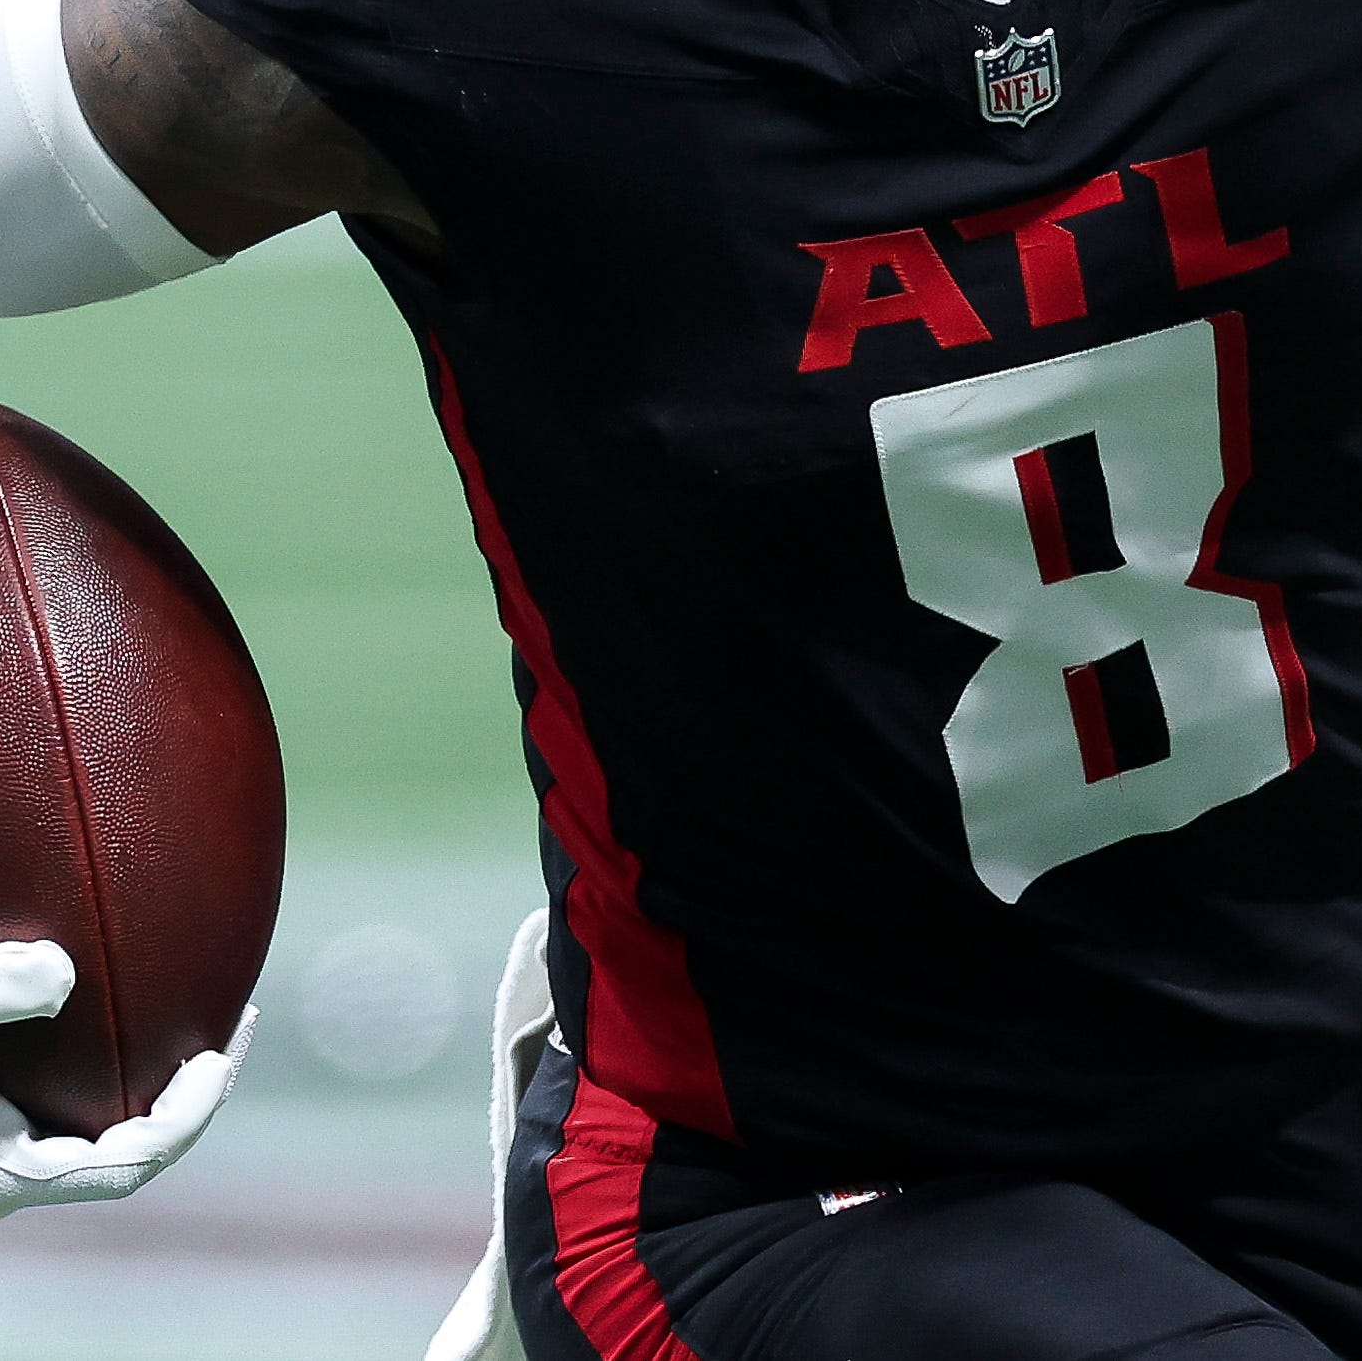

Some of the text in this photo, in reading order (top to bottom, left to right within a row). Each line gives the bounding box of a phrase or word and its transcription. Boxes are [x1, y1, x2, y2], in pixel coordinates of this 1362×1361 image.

[990, 69, 1050, 113] NFL
[796, 146, 1290, 374] ATL
[868, 309, 1317, 905] 8
